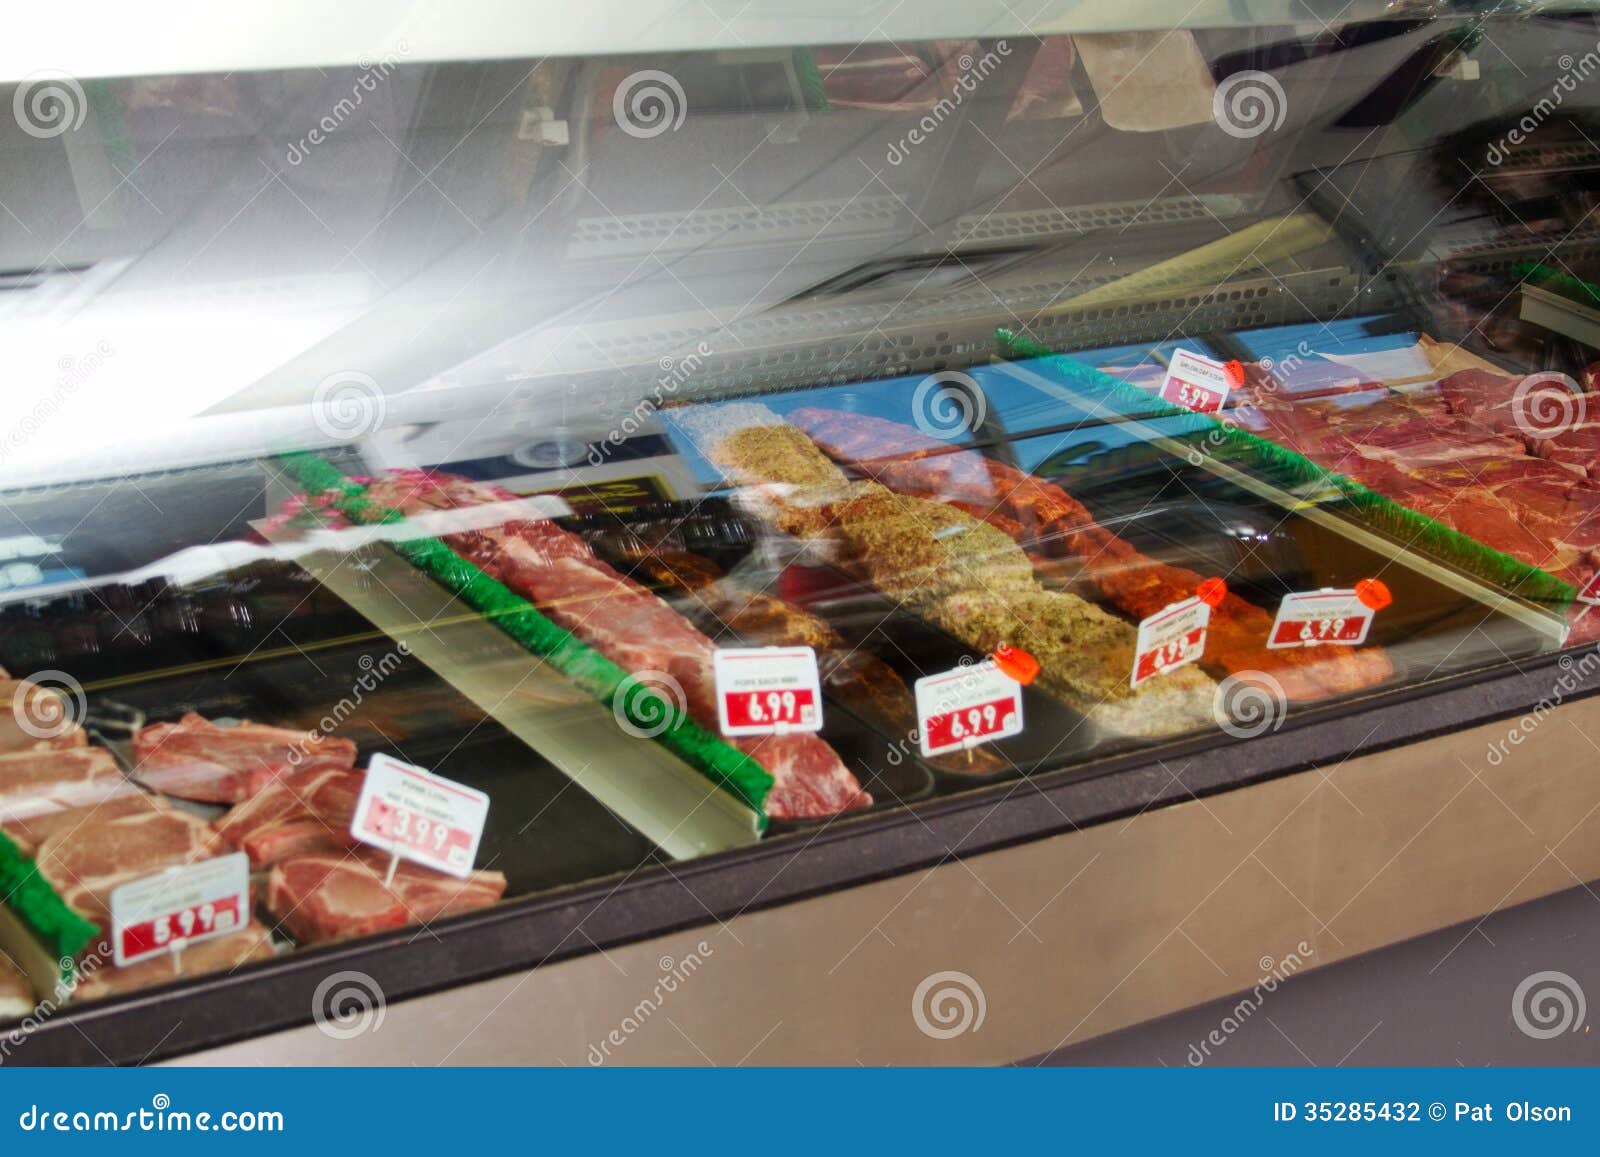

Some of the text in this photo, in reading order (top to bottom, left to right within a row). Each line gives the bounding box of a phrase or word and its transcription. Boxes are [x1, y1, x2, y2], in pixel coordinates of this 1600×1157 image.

[1178, 384, 1210, 408] 5.99
[1299, 618, 1346, 639] 6.99
[748, 691, 796, 721] 6.99
[950, 704, 996, 738] 6.99
[392, 811, 449, 851] 3.99
[153, 903, 216, 944] 5.99
